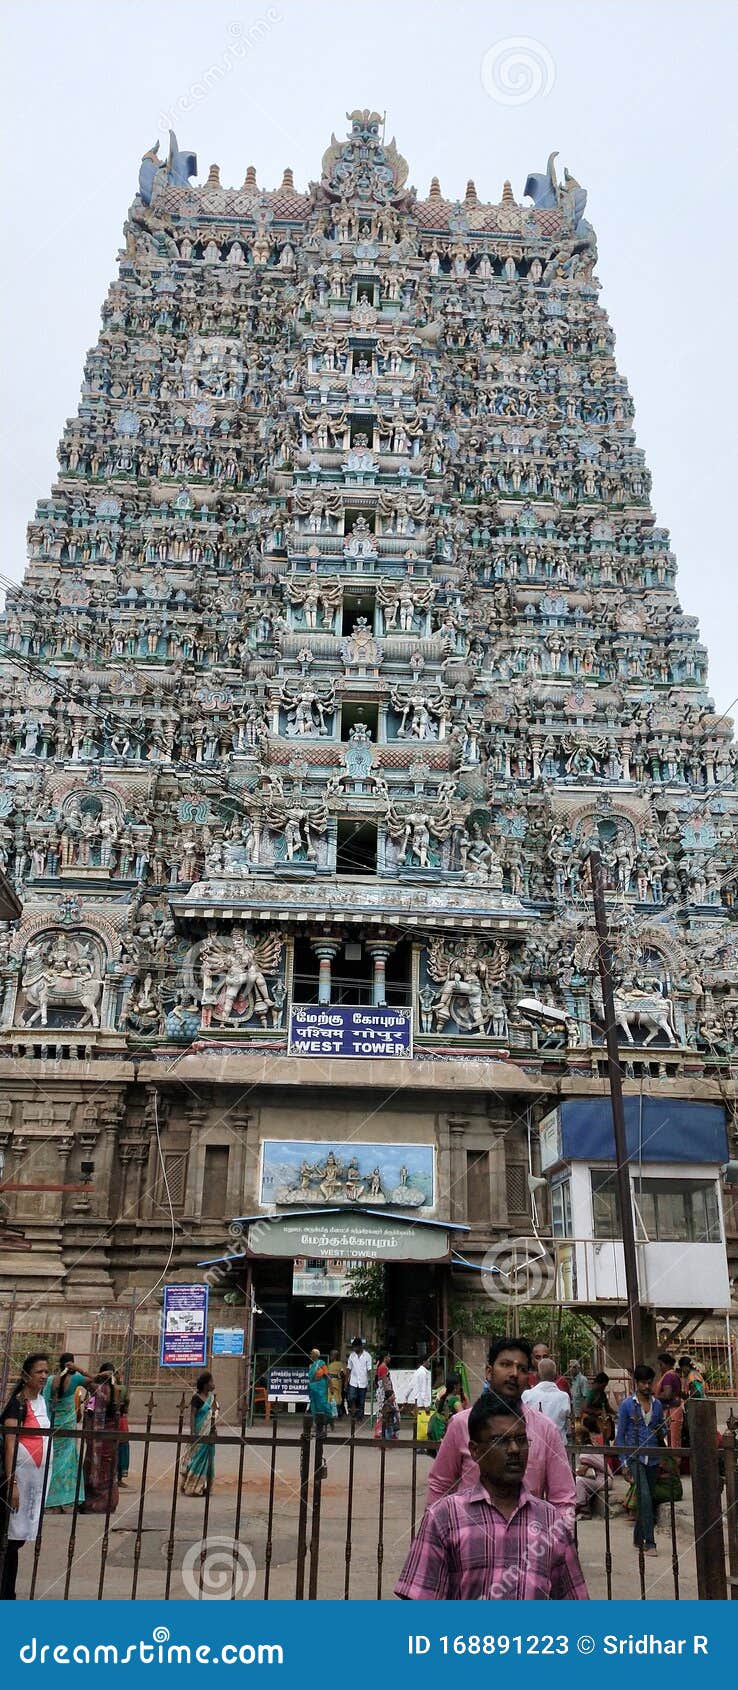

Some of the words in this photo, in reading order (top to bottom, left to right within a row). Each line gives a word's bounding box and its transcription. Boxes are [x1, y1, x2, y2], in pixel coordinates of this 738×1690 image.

[296, 1012, 344, 1026] மேற்கு
[352, 1013, 405, 1028] கோபுரம்
[296, 1026, 344, 1039] पश्चिम
[352, 1028, 405, 1042] गोपुर
[295, 1041, 343, 1052] WEST
[353, 1043, 405, 1054] TOWER
[320, 1249, 344, 1257] WEST
